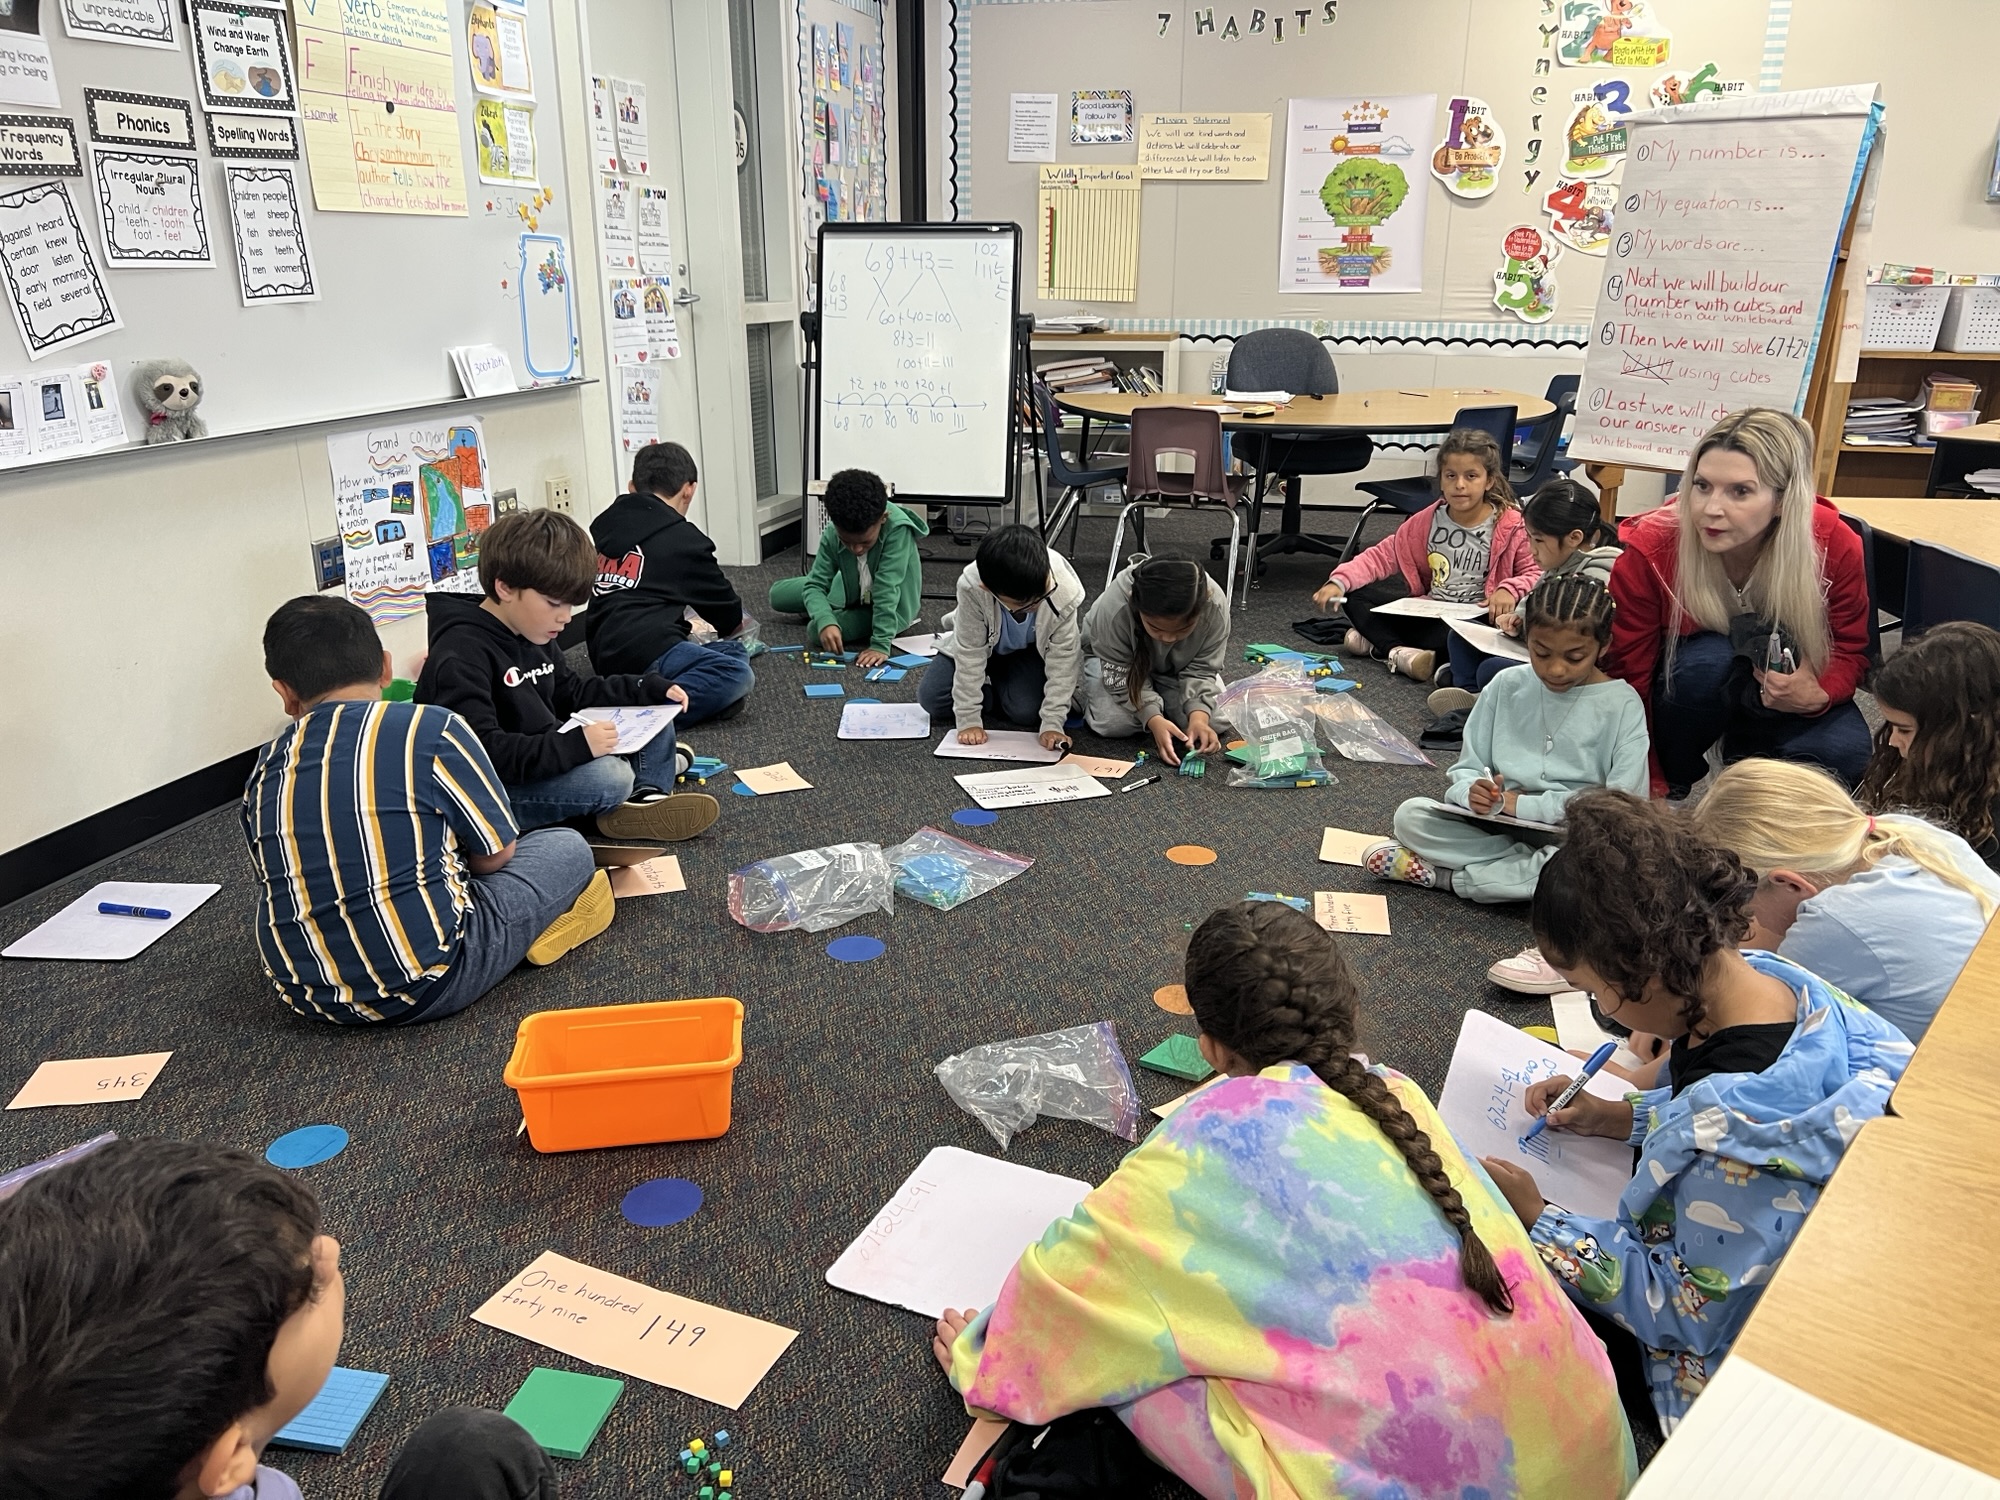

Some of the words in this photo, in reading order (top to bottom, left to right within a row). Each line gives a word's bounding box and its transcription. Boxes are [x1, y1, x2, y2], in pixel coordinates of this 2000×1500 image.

[83, 3, 155, 24] unpredictable
[1157, 13, 1172, 36] 7
[1194, 1, 1337, 43] HABITS
[206, 25, 227, 38] Wind
[229, 30, 244, 40] and
[244, 30, 270, 43] Water
[1561, 30, 1590, 40] HABIT
[18, 49, 49, 65] known
[213, 41, 244, 57] Change
[246, 45, 270, 57] Earth
[1614, 45, 1630, 55] Begin
[305, 38, 323, 79] F
[9, 66, 21, 75] or
[23, 65, 48, 81] being
[350, 47, 391, 91] Finish
[393, 80, 413, 100] your
[1714, 83, 1745, 92] HABIT
[1574, 93, 1604, 102] HABIT
[1459, 105, 1487, 116] HABIT
[116, 112, 171, 134] Phonics
[0, 129, 64, 147] Frequency
[218, 126, 255, 143] Spelling
[257, 128, 290, 142] Words
[396, 116, 421, 149] story
[1146, 130, 1161, 138] We
[1593, 135, 1604, 145] Put
[1606, 132, 1622, 142] First
[0, 147, 43, 161] Words
[1588, 143, 1609, 154] Things
[1611, 141, 1626, 151] First
[1650, 139, 1680, 172] My
[1689, 140, 1768, 161] number
[110, 169, 155, 185] Irregular
[359, 165, 391, 185] author
[393, 168, 413, 187] tells
[135, 184, 165, 197] Nouns
[234, 191, 260, 202] children
[262, 192, 288, 204] people
[1556, 180, 1583, 197] HABIT
[1594, 187, 1611, 196] Think
[118, 204, 141, 215] child
[152, 205, 189, 217] children
[1548, 181, 1586, 234] 4
[1643, 189, 1667, 218] My
[1674, 190, 1739, 218] equation
[125, 217, 150, 228] teeth
[160, 218, 185, 229] tooth
[243, 208, 256, 220] feet
[267, 209, 290, 222] sheep
[2, 225, 33, 245] against
[36, 216, 64, 234] heard
[133, 229, 153, 241] foot
[164, 230, 182, 242] feet
[247, 227, 259, 239] fish
[268, 227, 296, 238] shelves
[10, 243, 39, 262] certain
[45, 235, 68, 250] knew
[248, 245, 264, 257] lives
[274, 245, 295, 256] teeth
[1634, 228, 1657, 259] My
[1660, 234, 1713, 252] words
[20, 263, 40, 278] door
[52, 253, 75, 267] listen
[252, 266, 267, 275] men
[274, 263, 302, 274] women
[25, 280, 48, 297] early
[52, 268, 88, 288] morning
[1496, 271, 1523, 282] HABIT
[1497, 258, 1536, 309] 5
[1625, 267, 1659, 289] Next
[1663, 278, 1685, 290] we
[1689, 270, 1715, 291] will
[1720, 270, 1759, 293] build
[1760, 281, 1790, 294] our
[33, 296, 53, 313] field
[60, 285, 92, 304] several
[1624, 290, 1690, 310] number
[1695, 298, 1729, 312] with
[1779, 300, 1804, 315] and
[1661, 309, 1672, 319] it
[1618, 323, 1657, 347] Then
[1731, 337, 1763, 355] solve
[1678, 366, 1720, 391] using
[1730, 368, 1771, 384] cubes
[1604, 390, 1647, 412] Last
[1652, 403, 1674, 416] we
[1679, 400, 1706, 419] will
[1600, 416, 1631, 429] our
[1635, 419, 1687, 435] answer
[367, 431, 399, 454] Grand
[1656, 446, 1673, 454] and
[1431, 527, 1467, 549] DO
[1452, 549, 1489, 571] WHA
[97, 1072, 148, 1091] 345
[521, 1270, 568, 1294] One
[574, 1283, 644, 1316] hundred
[502, 1288, 545, 1319] forty
[552, 1304, 588, 1325] nine
[639, 1315, 707, 1347] 149
